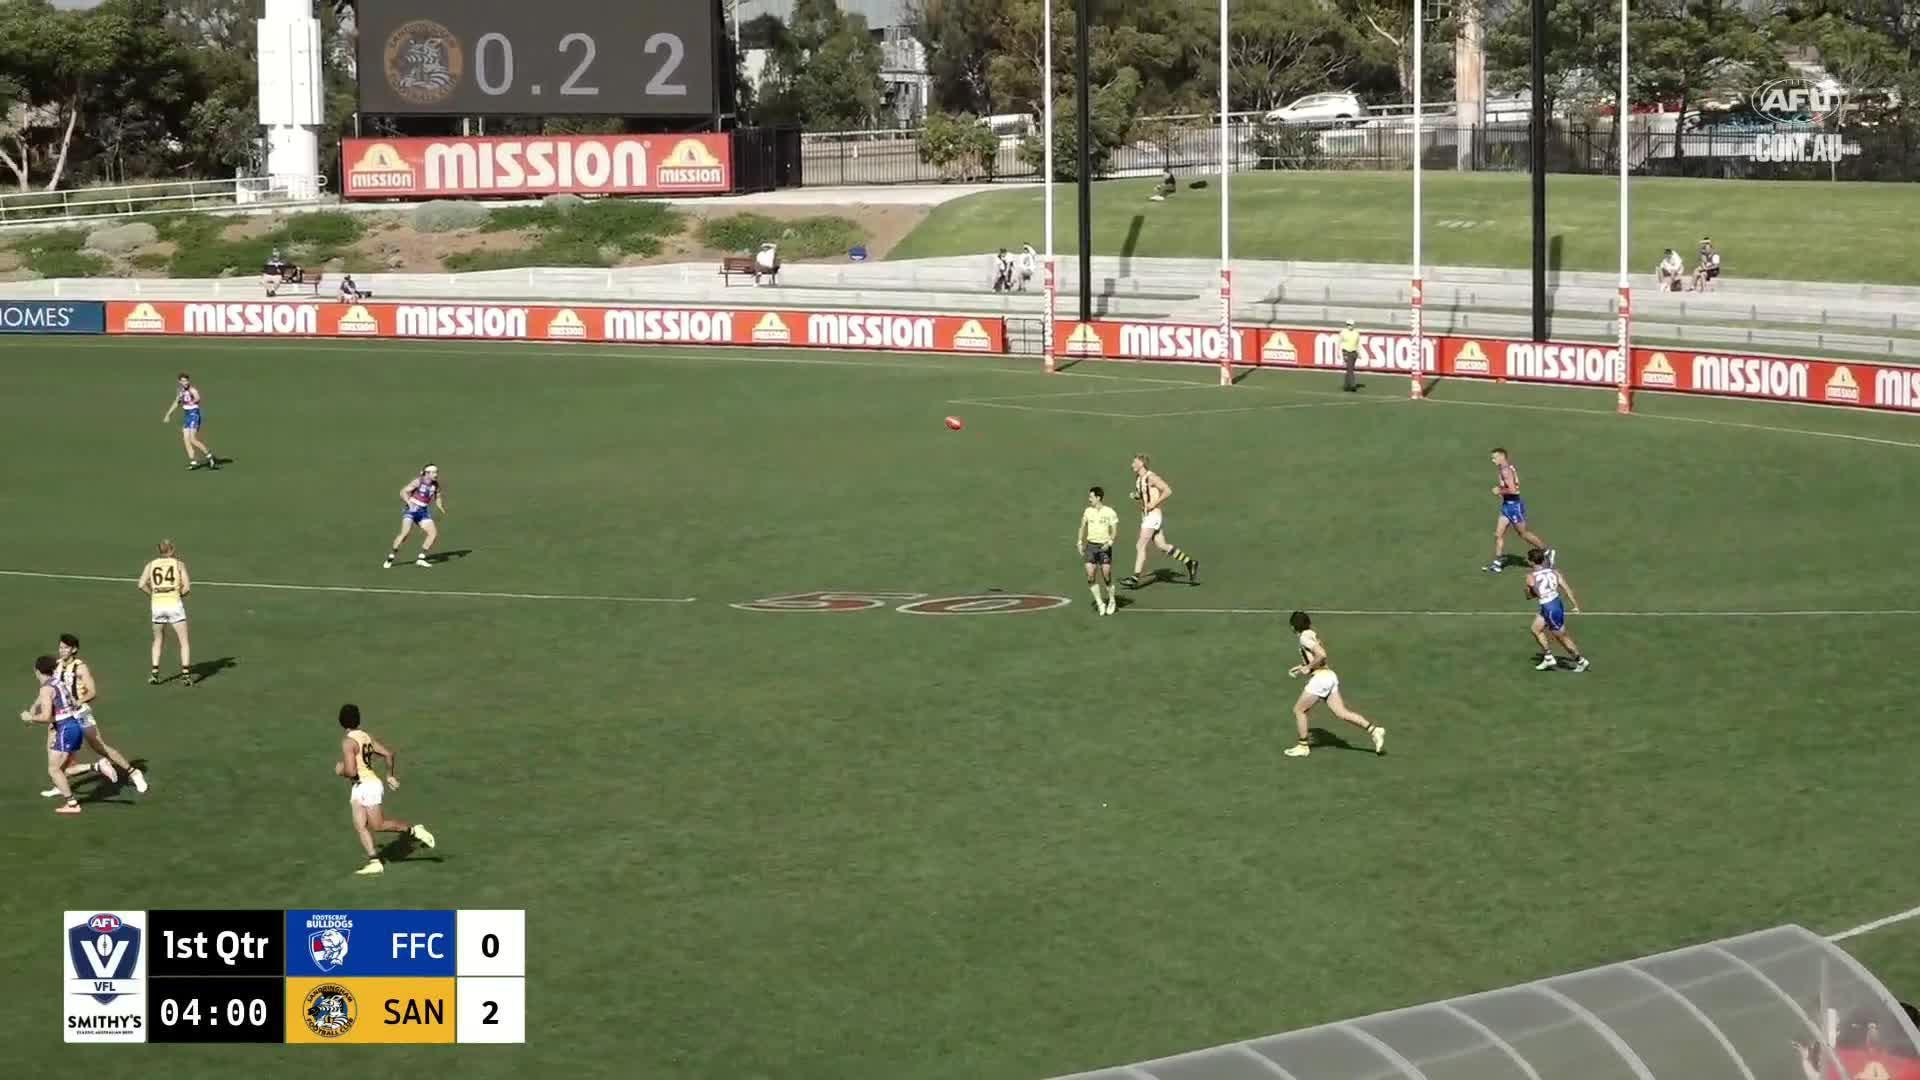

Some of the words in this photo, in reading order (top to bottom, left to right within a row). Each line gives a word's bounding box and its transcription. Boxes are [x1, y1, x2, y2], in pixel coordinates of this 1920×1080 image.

[644, 32, 687, 96] 2
[352, 173, 412, 189] MISSION
[425, 140, 647, 190] MISSION
[660, 168, 721, 184] MISSION
[184, 303, 317, 334] MISSION
[396, 305, 527, 337] MISSION
[604, 310, 733, 342] MISSION
[808, 314, 934, 348] MISSION
[1314, 333, 1435, 372] MSSION
[1692, 356, 1809, 398] MISSION
[152, 565, 175, 586] 64
[729, 590, 1072, 615] 50
